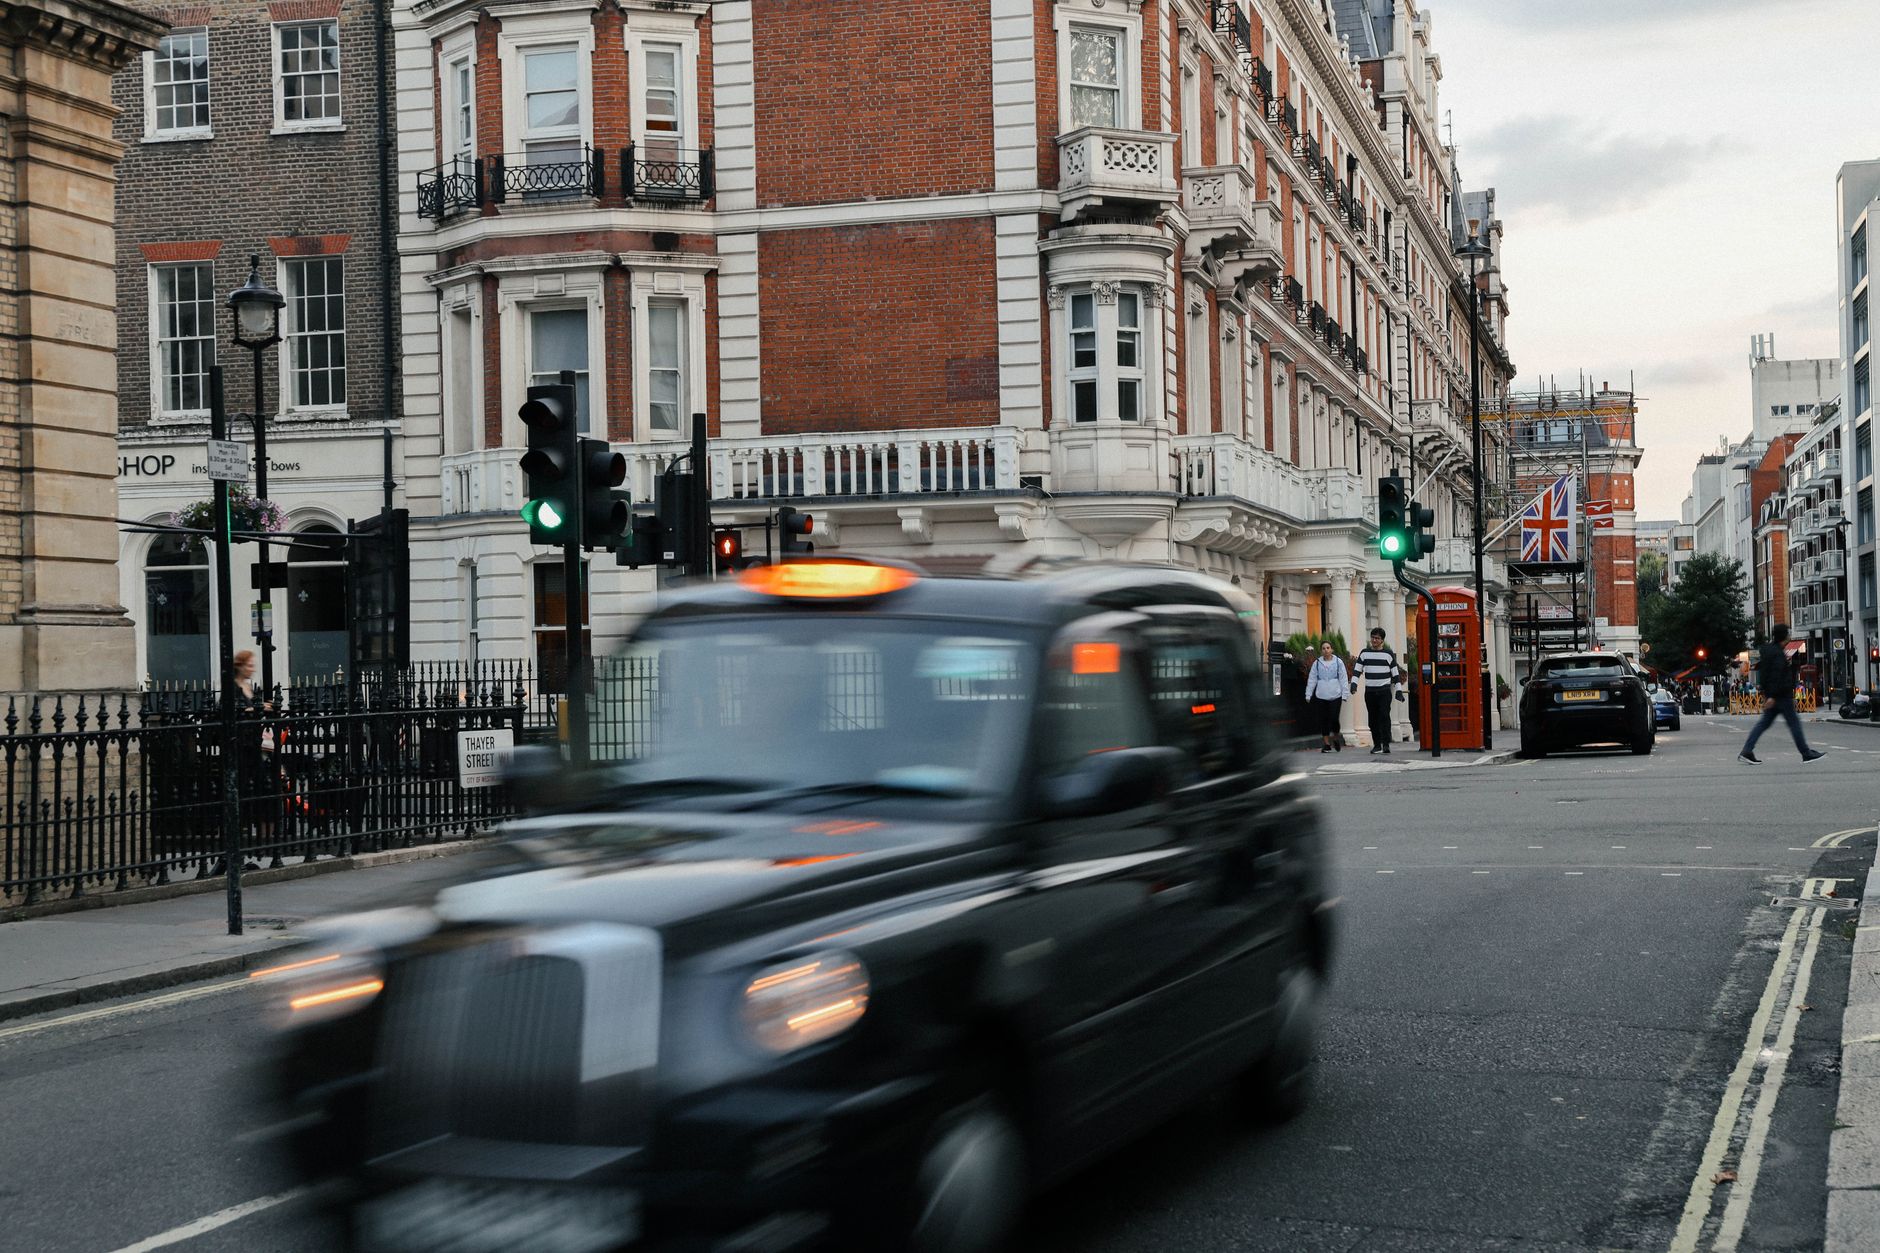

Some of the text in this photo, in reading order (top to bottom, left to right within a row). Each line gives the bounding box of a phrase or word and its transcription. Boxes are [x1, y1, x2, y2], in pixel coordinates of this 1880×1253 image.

[271, 461, 300, 471] bows
[465, 736, 495, 751] THAYER
[466, 753, 495, 768] STREET
